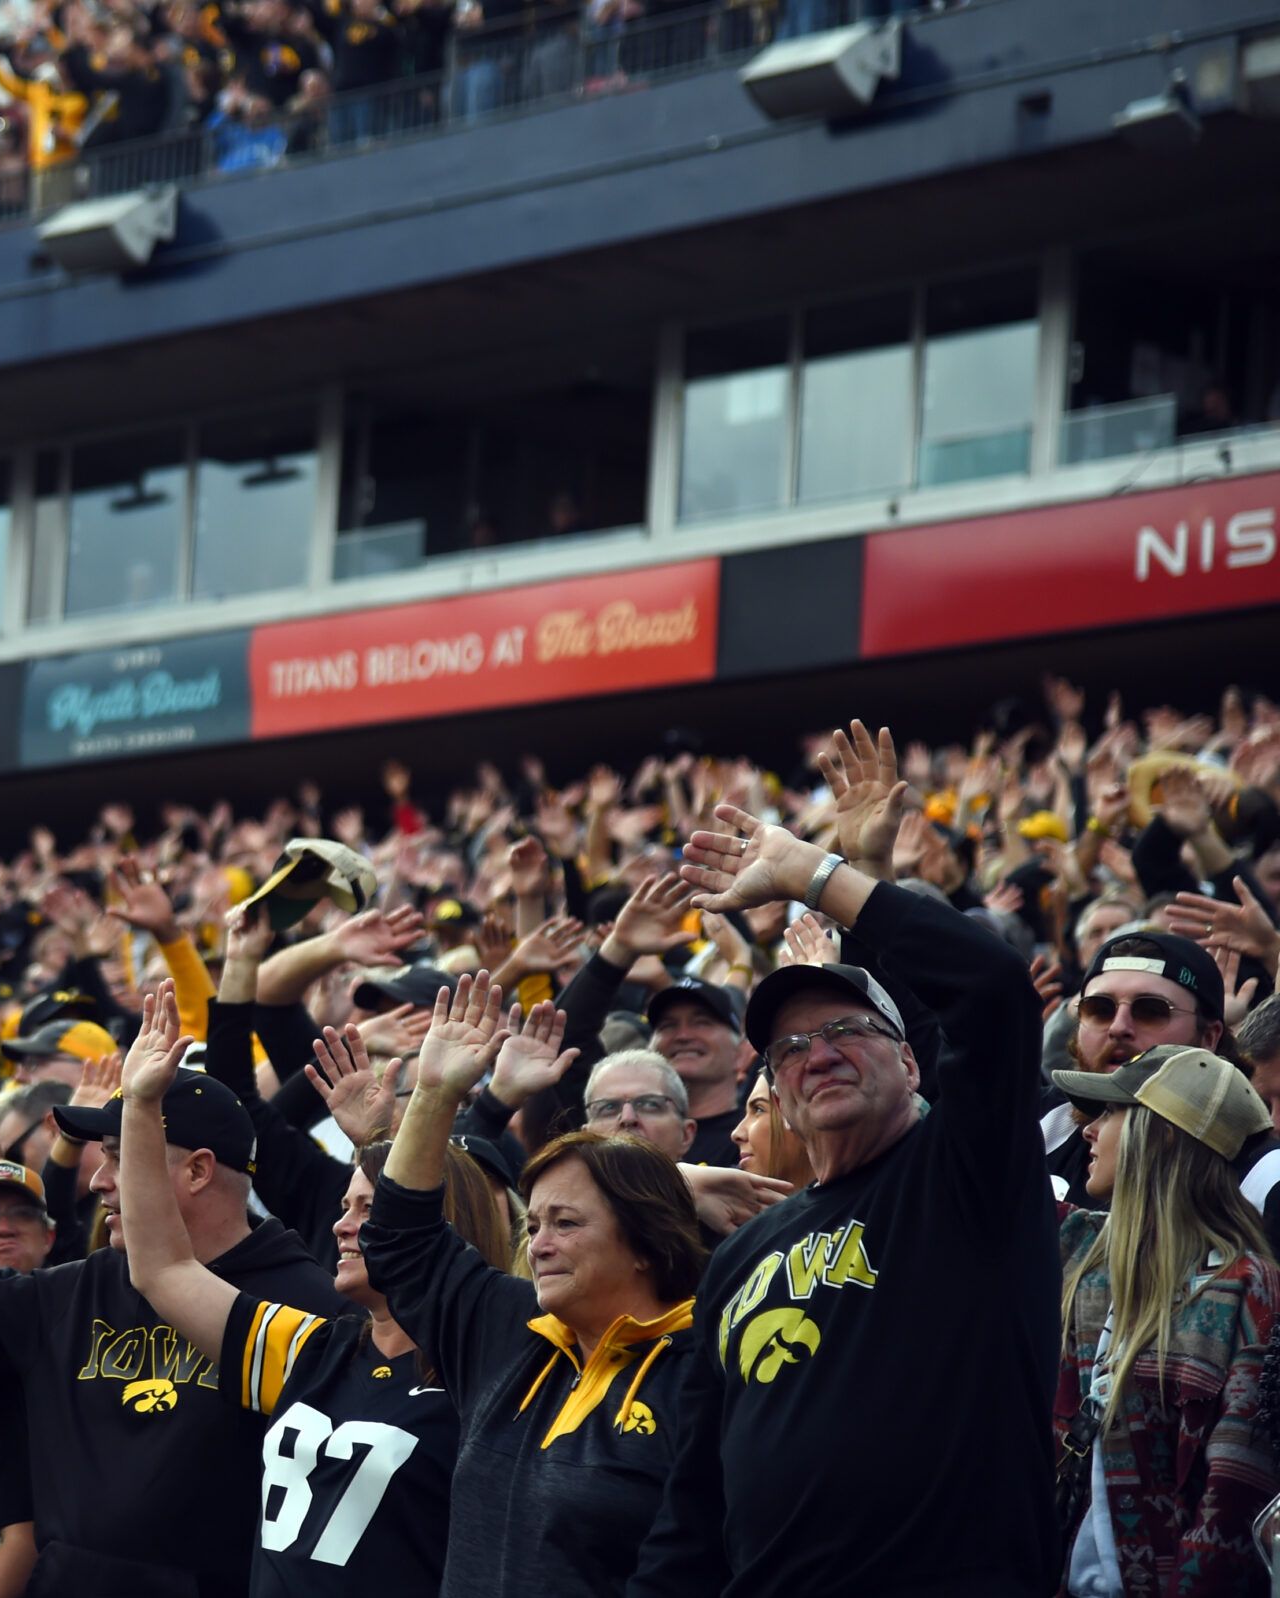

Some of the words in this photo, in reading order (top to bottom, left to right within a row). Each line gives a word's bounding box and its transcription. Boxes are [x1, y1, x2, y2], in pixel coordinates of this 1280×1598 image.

[1134, 506, 1277, 583] NIS
[140, 668, 221, 718] Beach
[269, 651, 358, 697] TITANS
[366, 632, 484, 686] BELONG
[490, 624, 526, 669] AT
[537, 609, 593, 664] The
[596, 599, 699, 656] Beach
[719, 1218, 879, 1373] IOWA
[261, 1401, 420, 1567] 87
